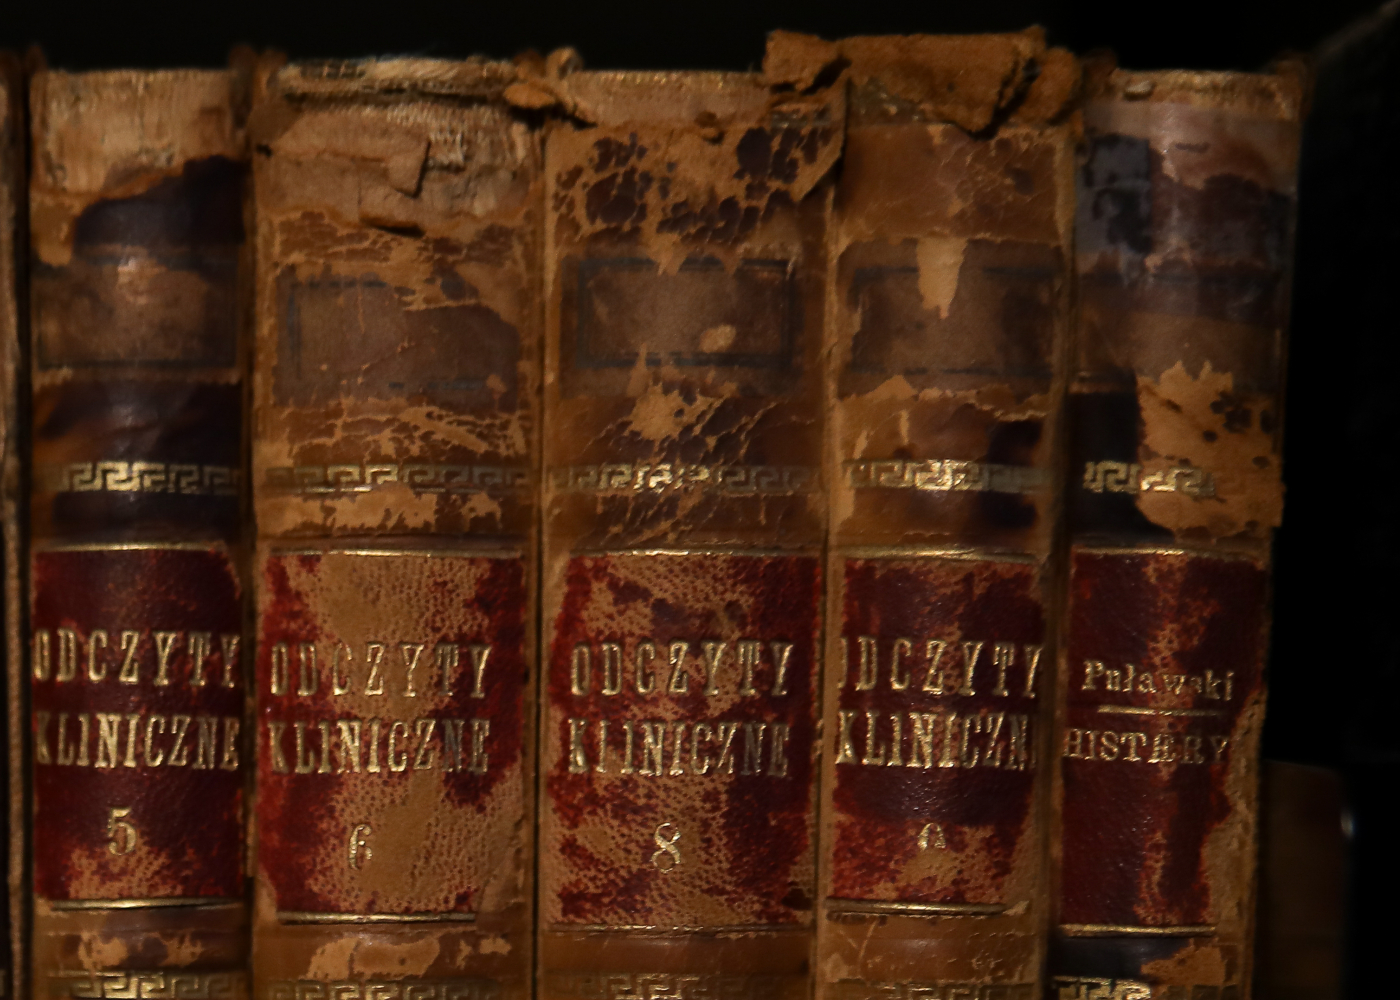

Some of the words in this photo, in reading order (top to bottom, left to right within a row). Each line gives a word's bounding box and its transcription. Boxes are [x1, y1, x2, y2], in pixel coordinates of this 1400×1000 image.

[33, 629, 240, 688] ODCZYTY
[271, 642, 492, 698] ODCZYTY
[571, 641, 794, 697] ODCZYTY
[35, 712, 240, 771] KLINICZNE
[268, 718, 491, 775] KLINICZNE
[568, 717, 792, 778] KLINICZNE
[835, 709, 1037, 771] KLINICZN
[106, 807, 138, 856] 5
[348, 825, 373, 870] 6
[652, 823, 682, 874] 8
